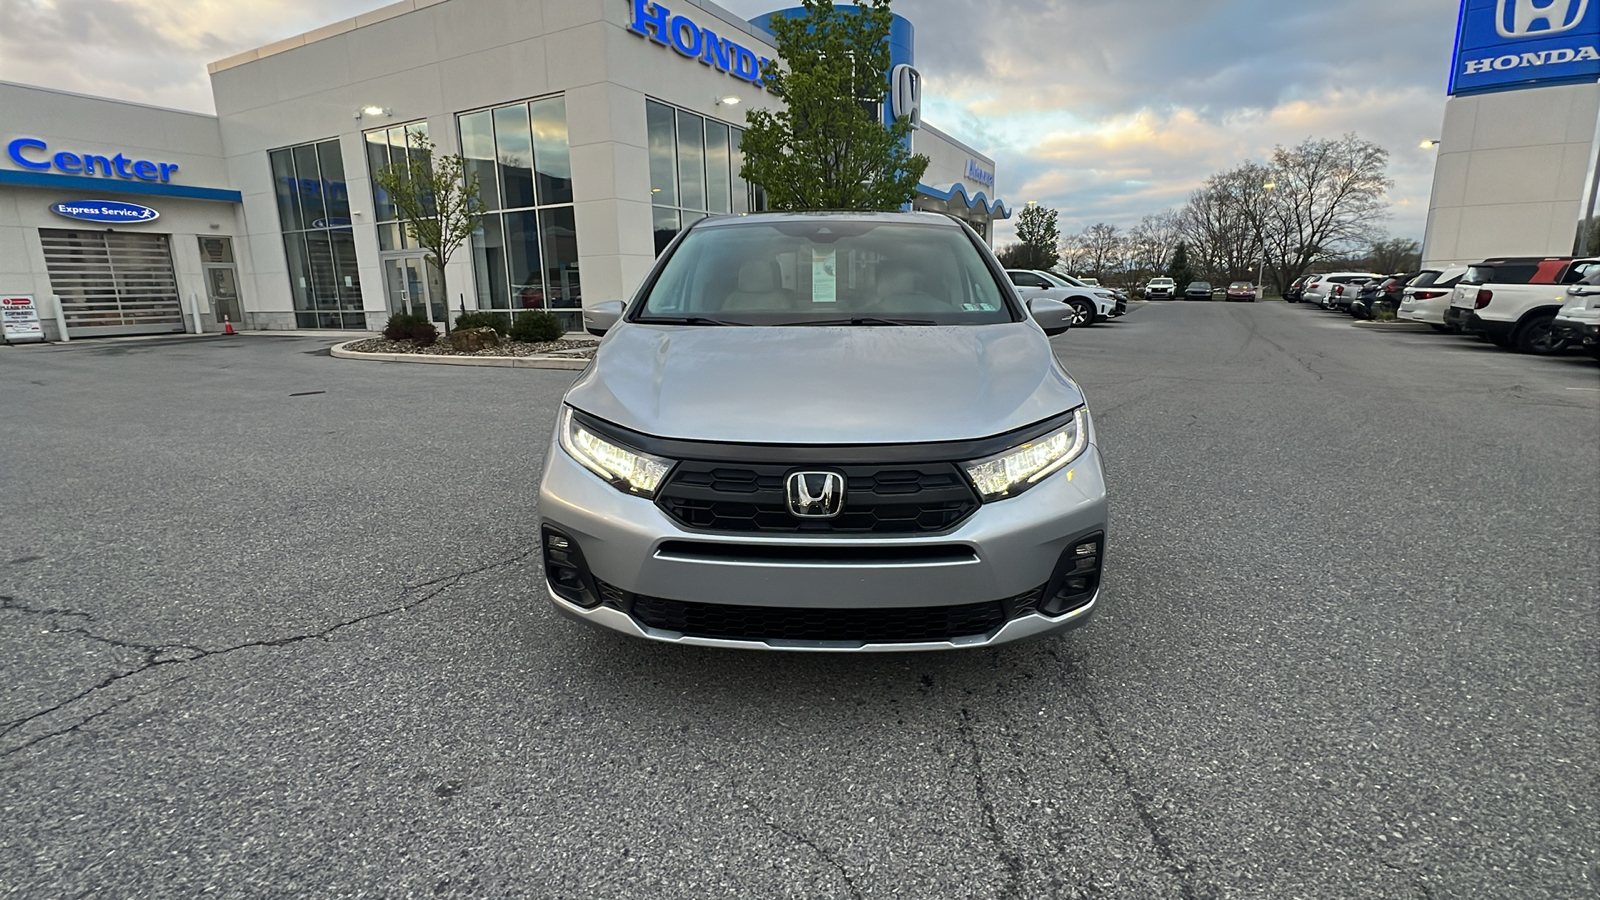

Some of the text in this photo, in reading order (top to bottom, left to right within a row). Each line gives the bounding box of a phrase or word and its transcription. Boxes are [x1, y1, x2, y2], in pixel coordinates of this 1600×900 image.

[1463, 45, 1600, 75] HONDA
[7, 138, 179, 183] Center
[58, 204, 139, 217] Express Service
